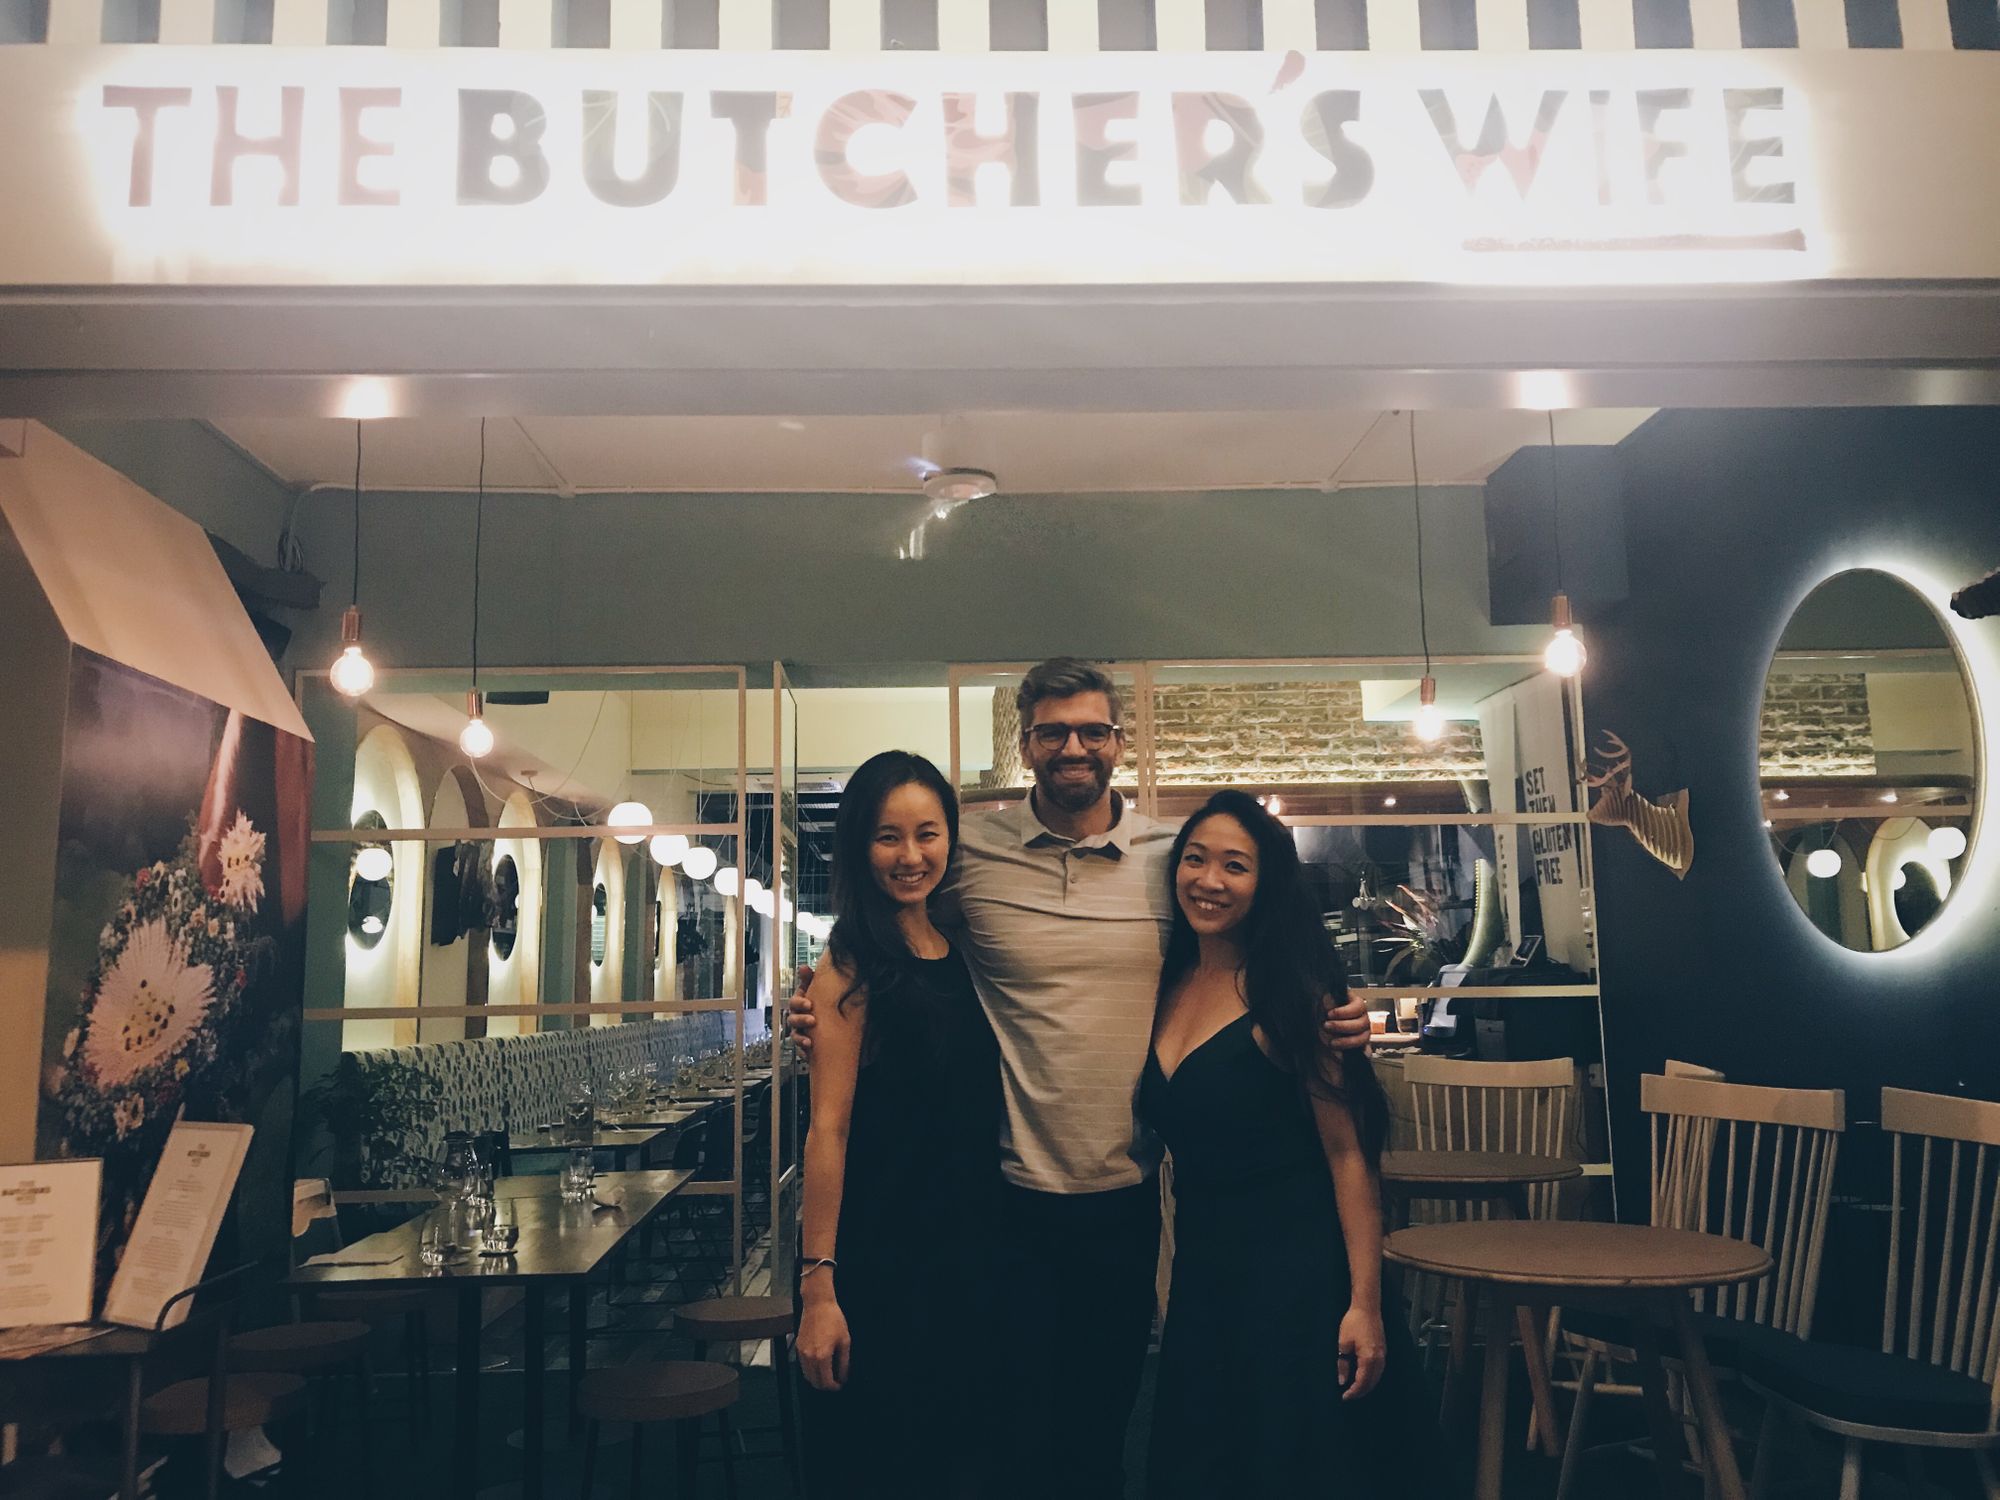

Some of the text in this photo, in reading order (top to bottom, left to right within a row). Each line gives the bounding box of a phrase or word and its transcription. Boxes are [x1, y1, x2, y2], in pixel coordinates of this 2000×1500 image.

[102, 49, 1796, 209] THE BUTCHER'S WIFE
[1526, 767, 1545, 795] SET
[1533, 824, 1572, 855] GLUTEN
[1536, 857, 1563, 887] FREE
